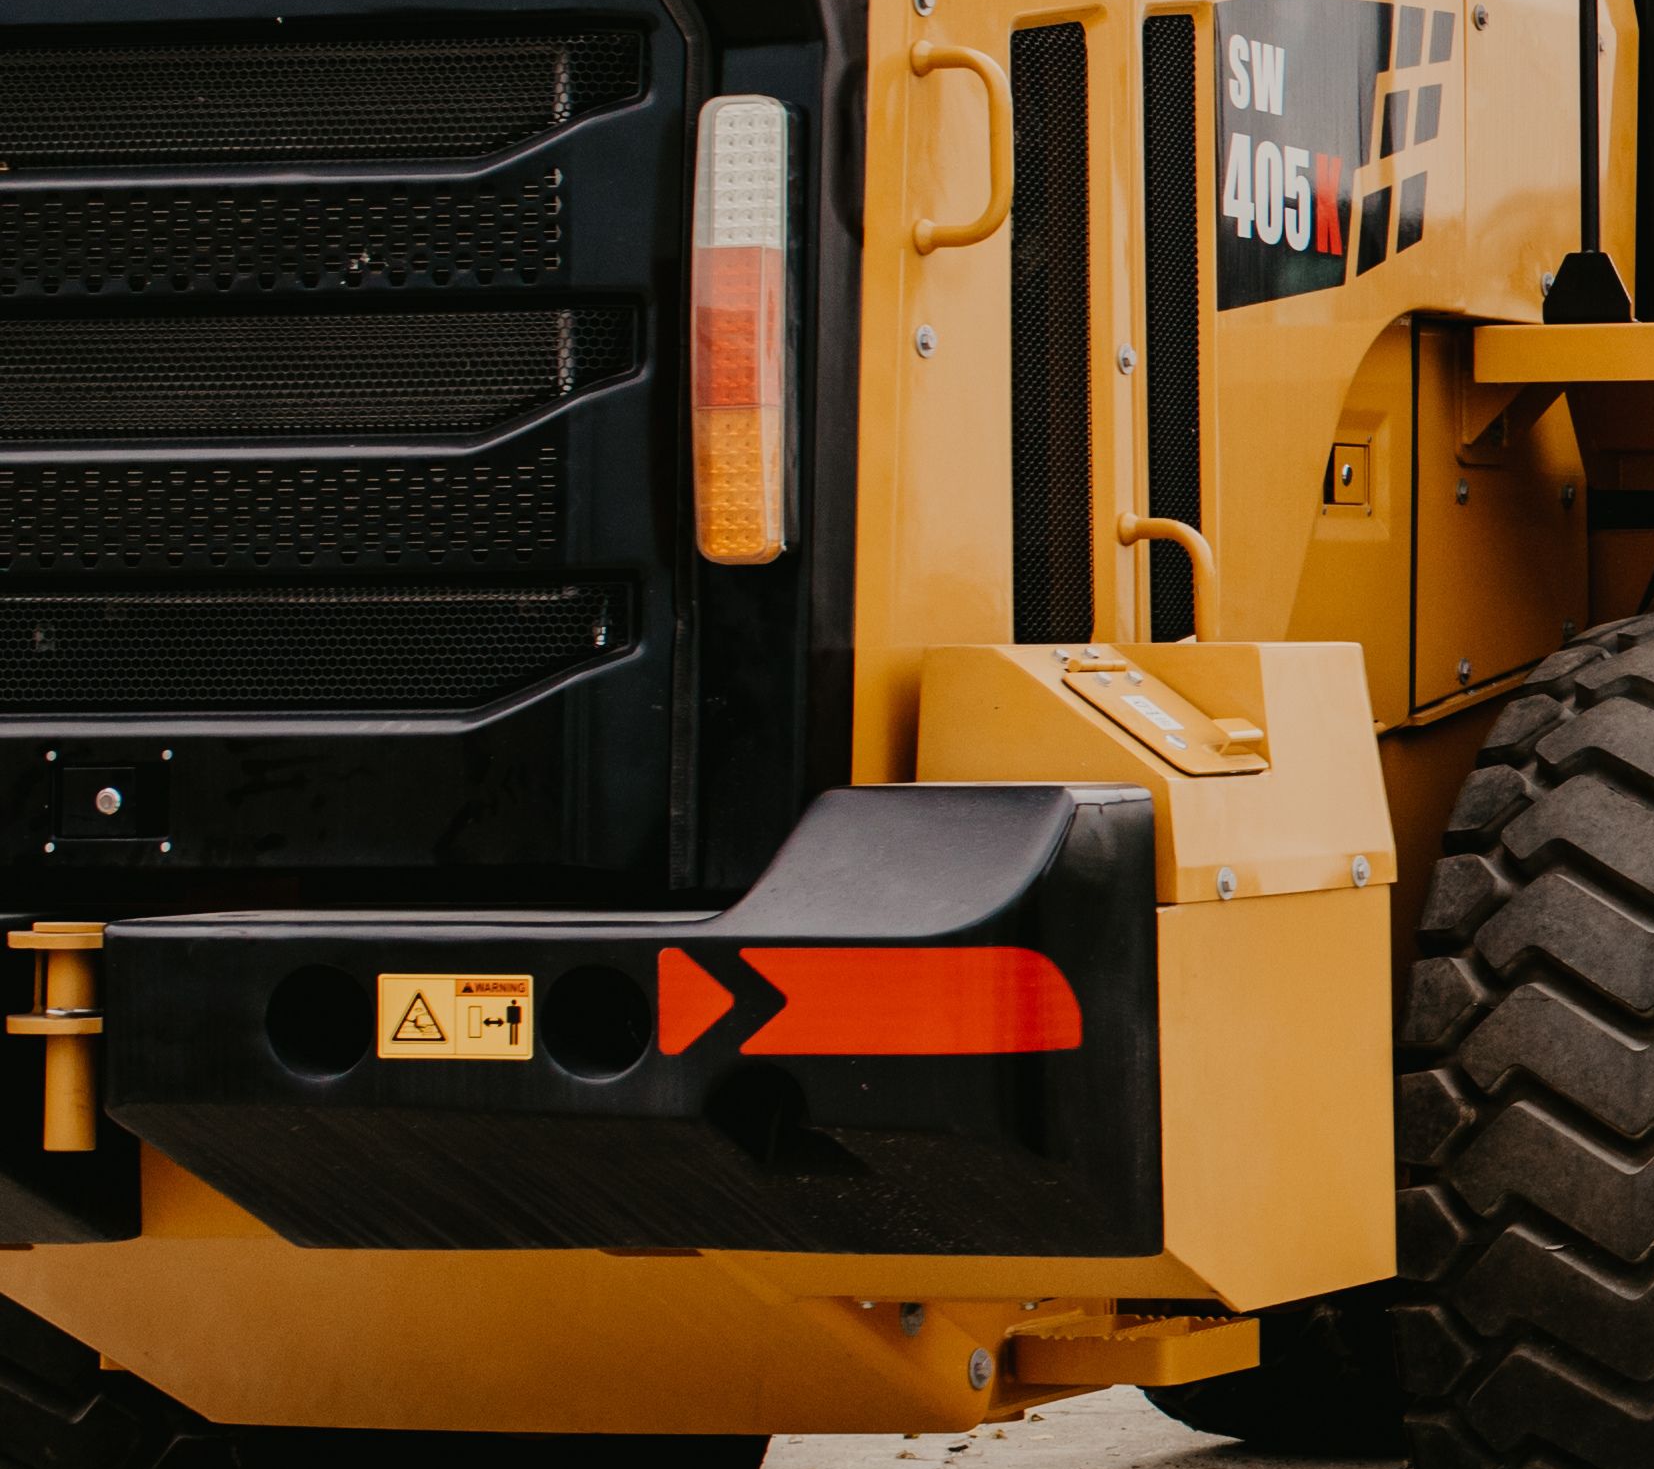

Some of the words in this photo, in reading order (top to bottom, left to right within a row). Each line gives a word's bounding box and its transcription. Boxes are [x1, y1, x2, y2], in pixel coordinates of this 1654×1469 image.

[1228, 33, 1286, 117] SW
[1223, 132, 1343, 257] 405K
[475, 982, 526, 993] WARNING
